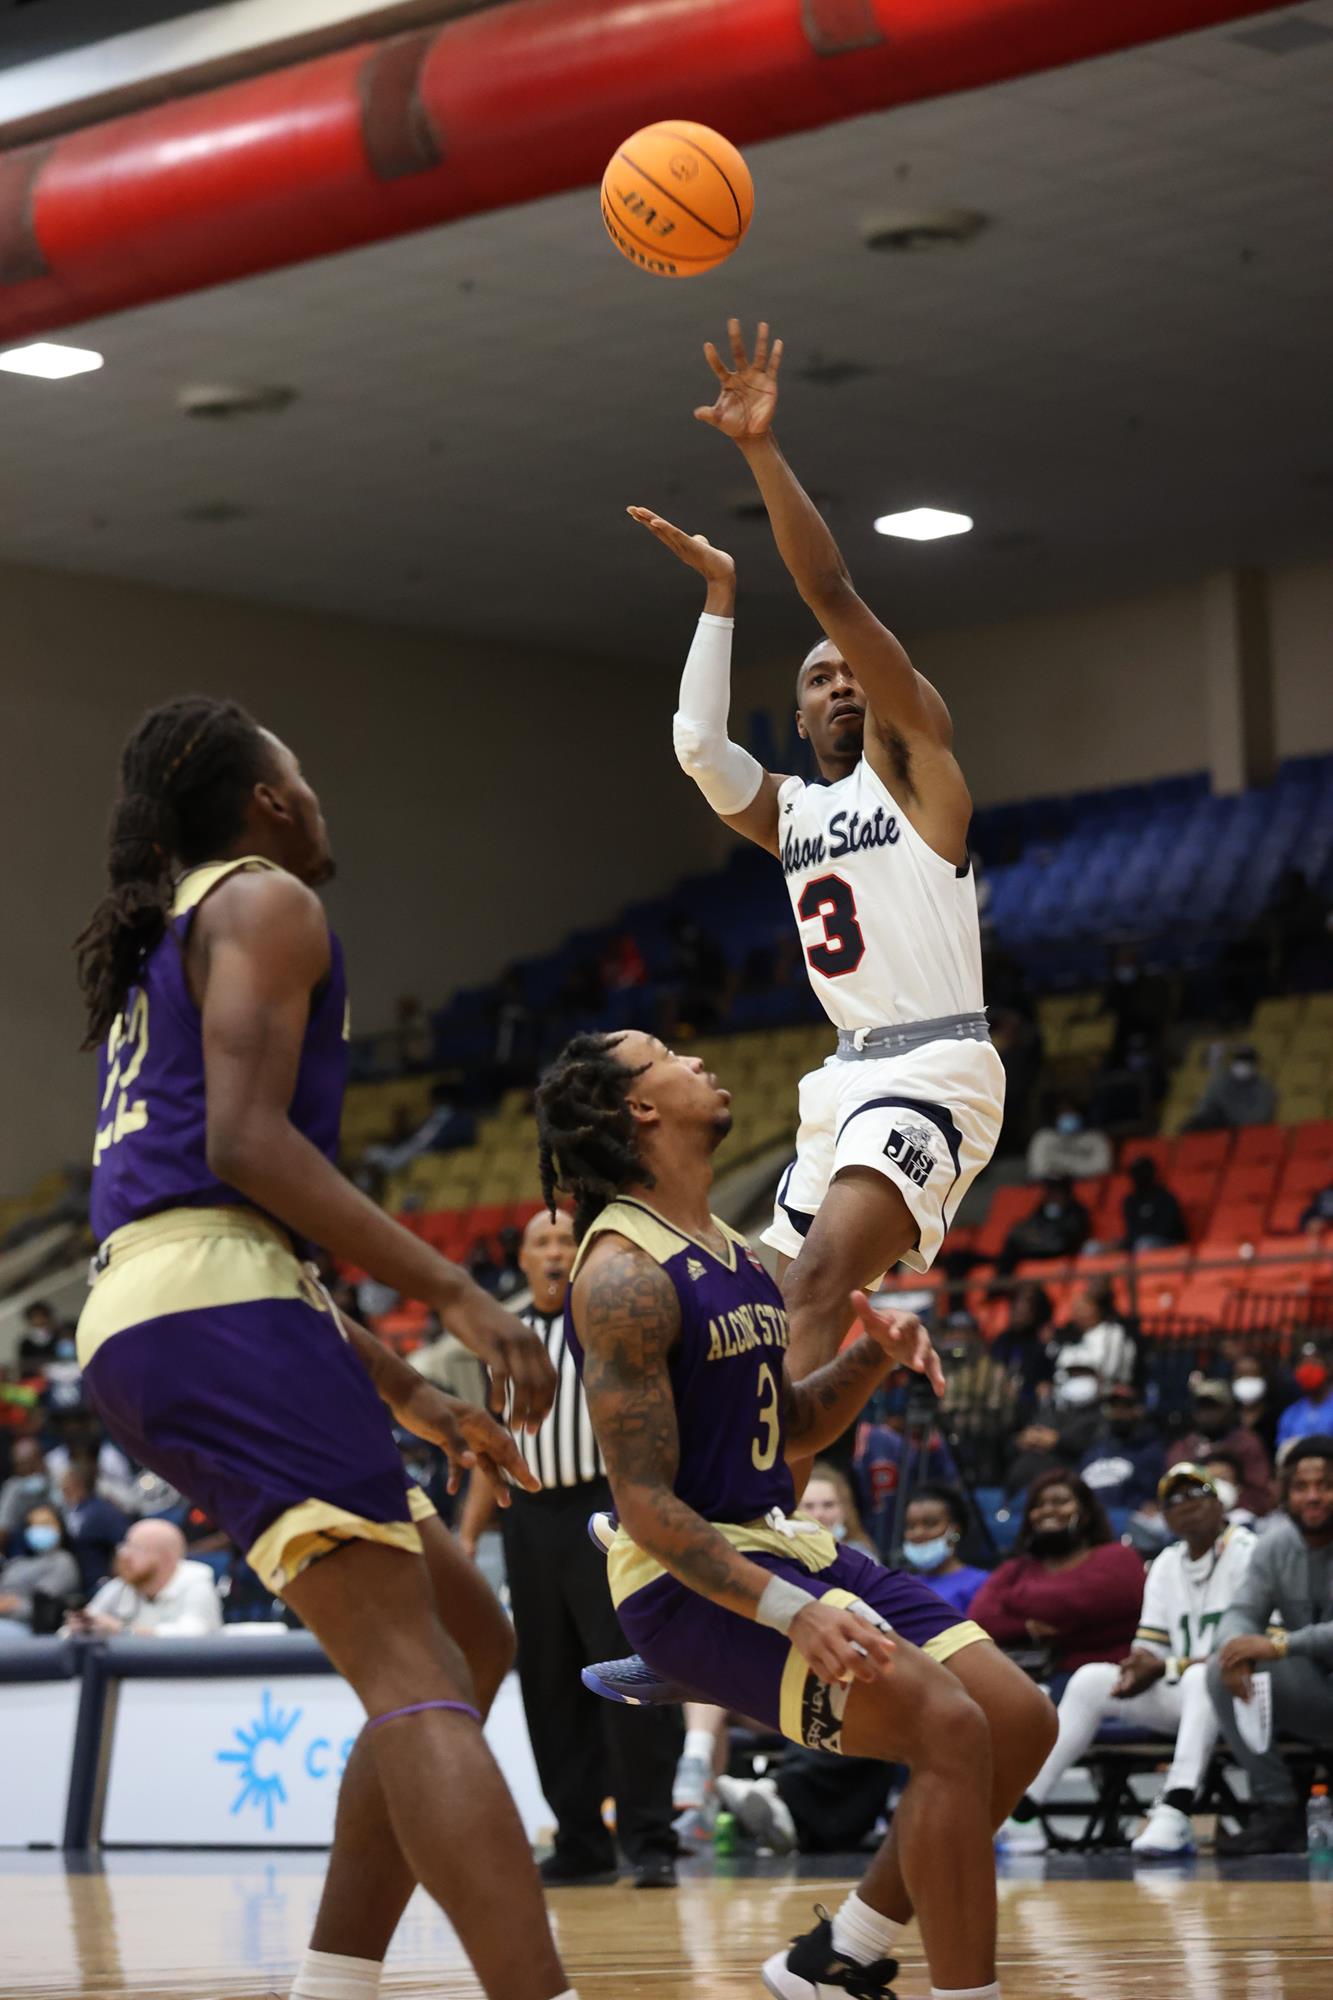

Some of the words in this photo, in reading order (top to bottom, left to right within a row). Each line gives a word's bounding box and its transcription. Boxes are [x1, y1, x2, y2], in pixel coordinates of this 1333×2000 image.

[829, 806, 900, 859] State
[797, 873, 866, 979] 3
[752, 1362, 780, 1472] 3
